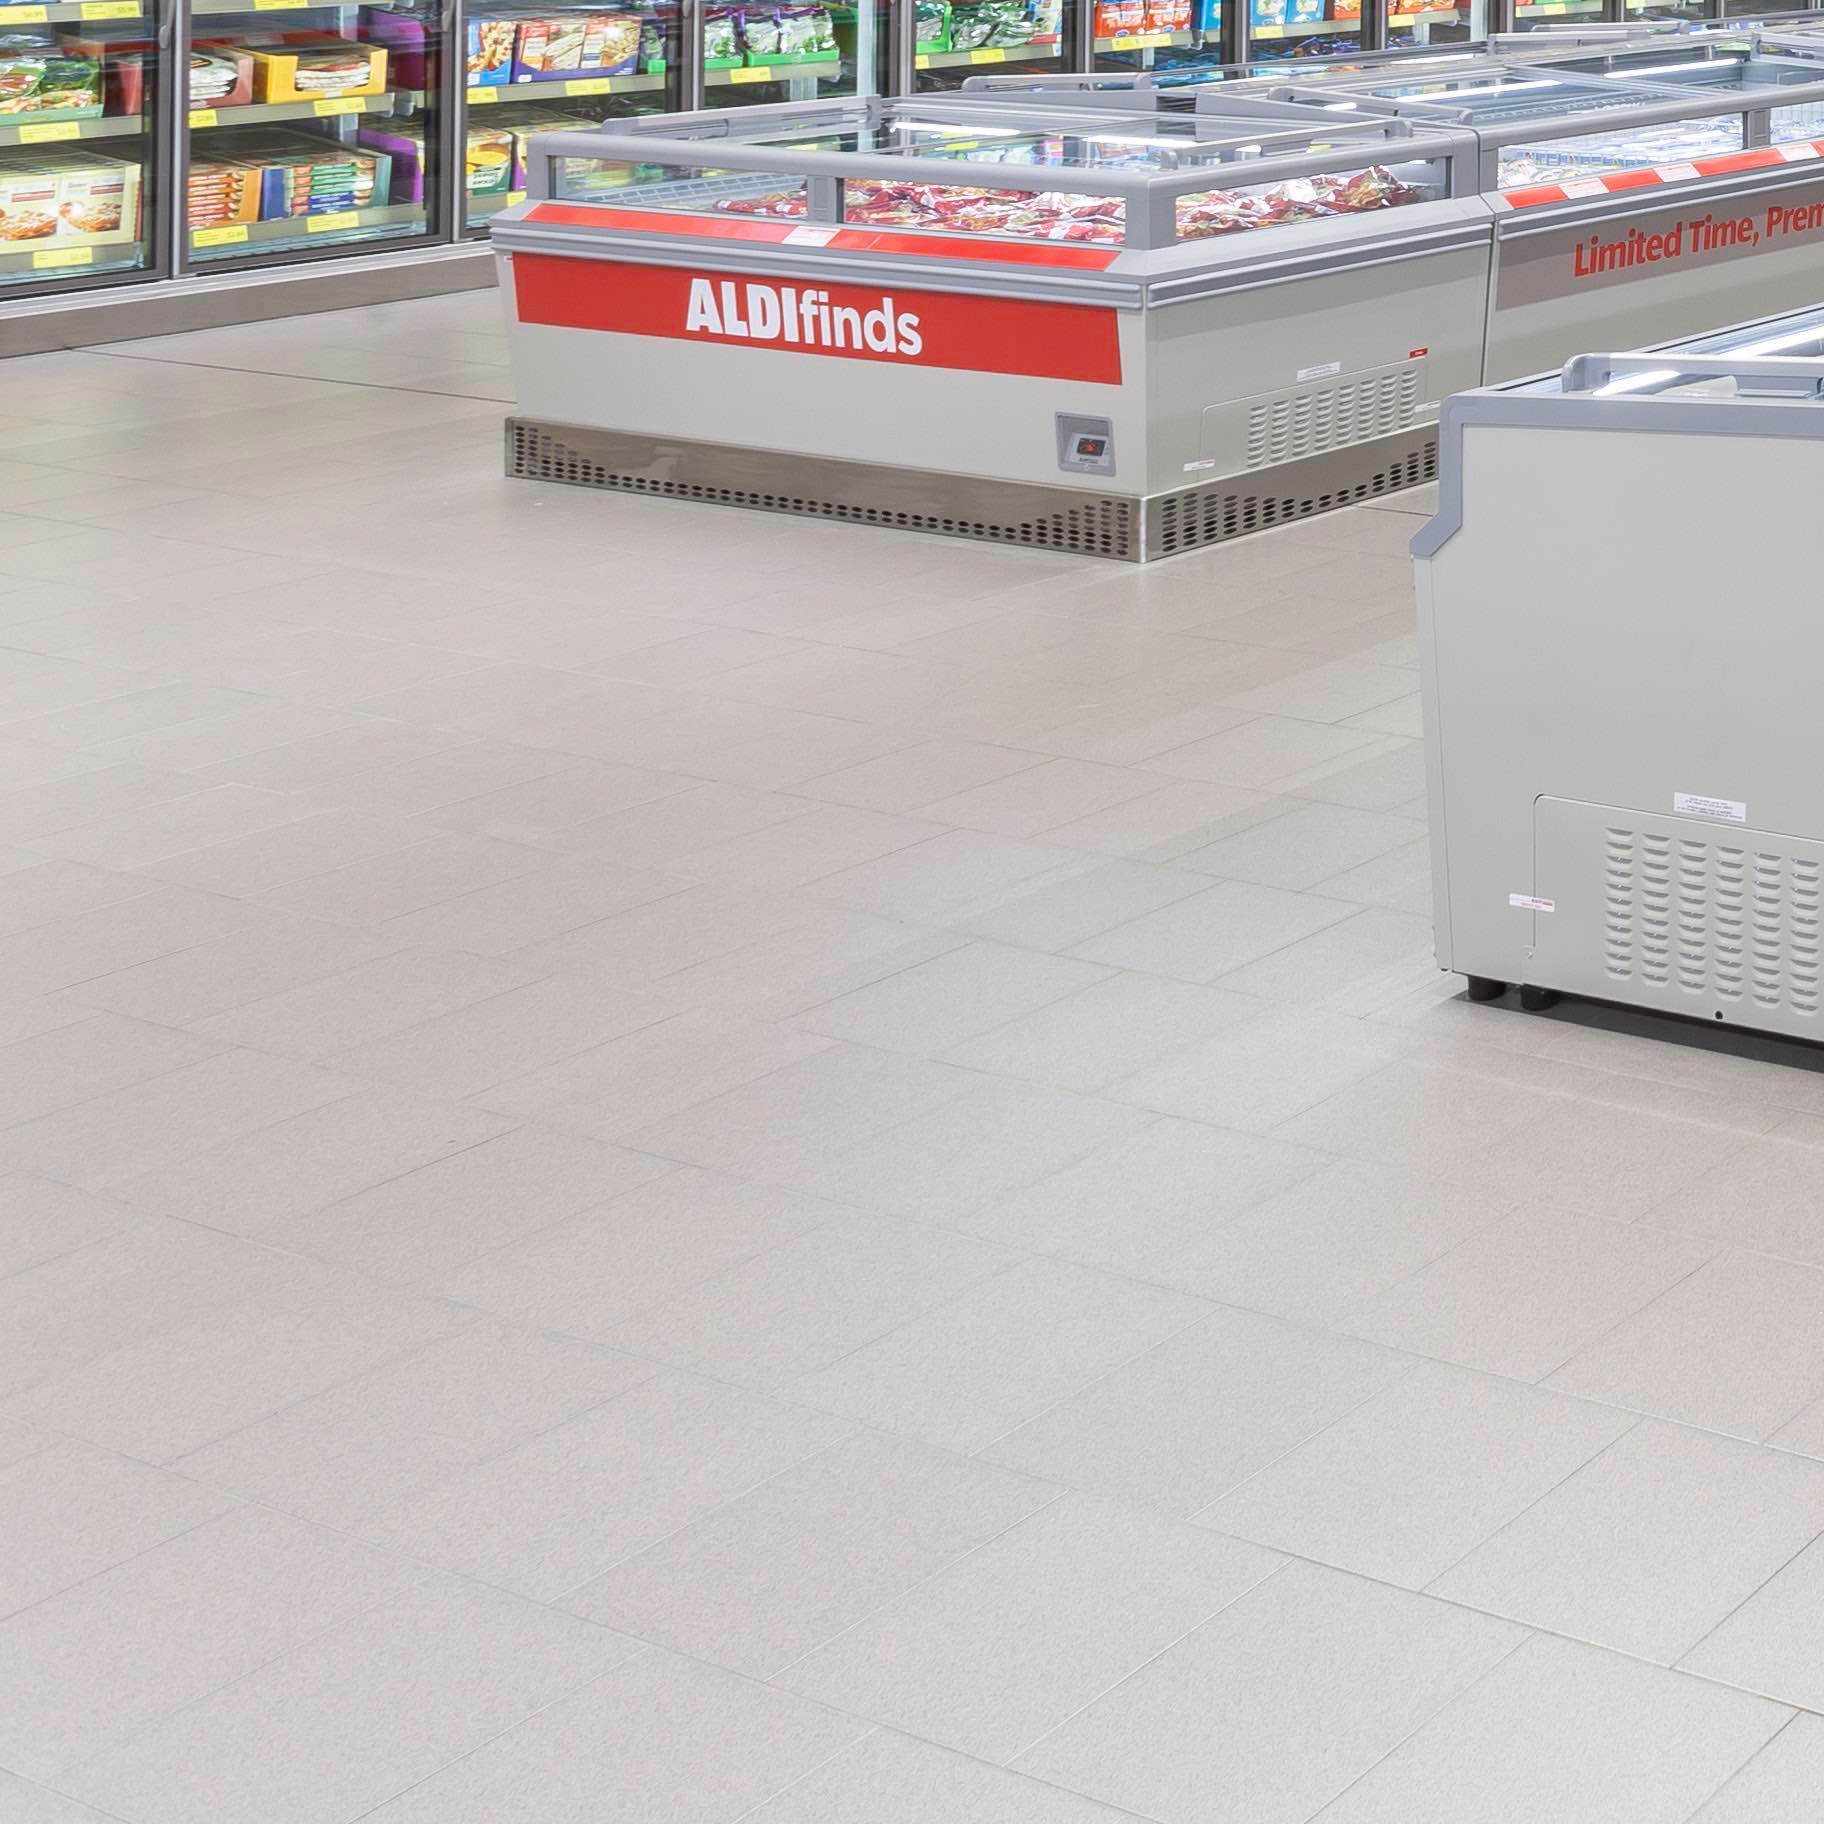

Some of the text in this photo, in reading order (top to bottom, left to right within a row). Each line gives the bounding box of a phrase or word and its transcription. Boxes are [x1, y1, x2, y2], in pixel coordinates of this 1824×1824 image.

[1575, 221, 1683, 278] Limited
[1688, 212, 1759, 254] Time,
[686, 277, 923, 357] ALDIfinds
